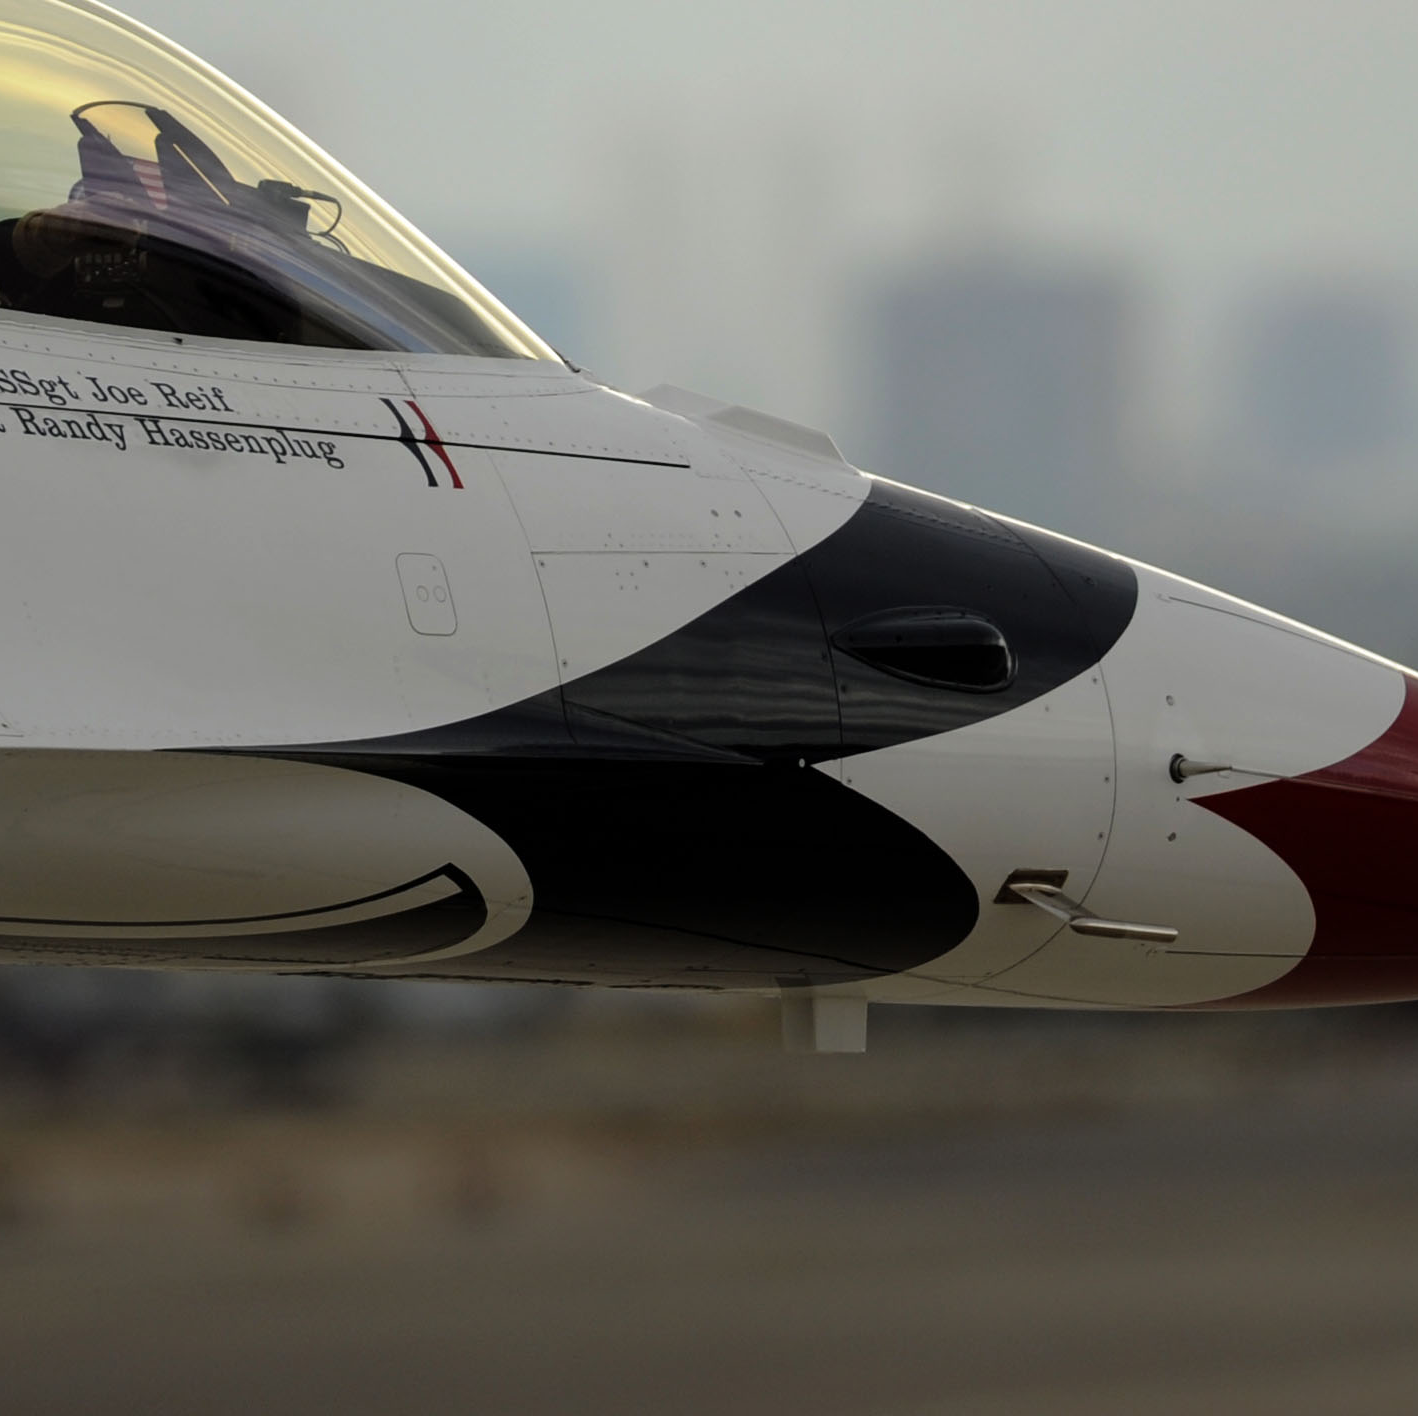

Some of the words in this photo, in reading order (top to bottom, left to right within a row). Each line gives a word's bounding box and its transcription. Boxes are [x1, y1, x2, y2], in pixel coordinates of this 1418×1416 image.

[85, 376, 148, 406] Joe
[149, 382, 234, 413] Reif
[9, 407, 127, 451] Randy
[134, 418, 345, 470] Hassenplug
